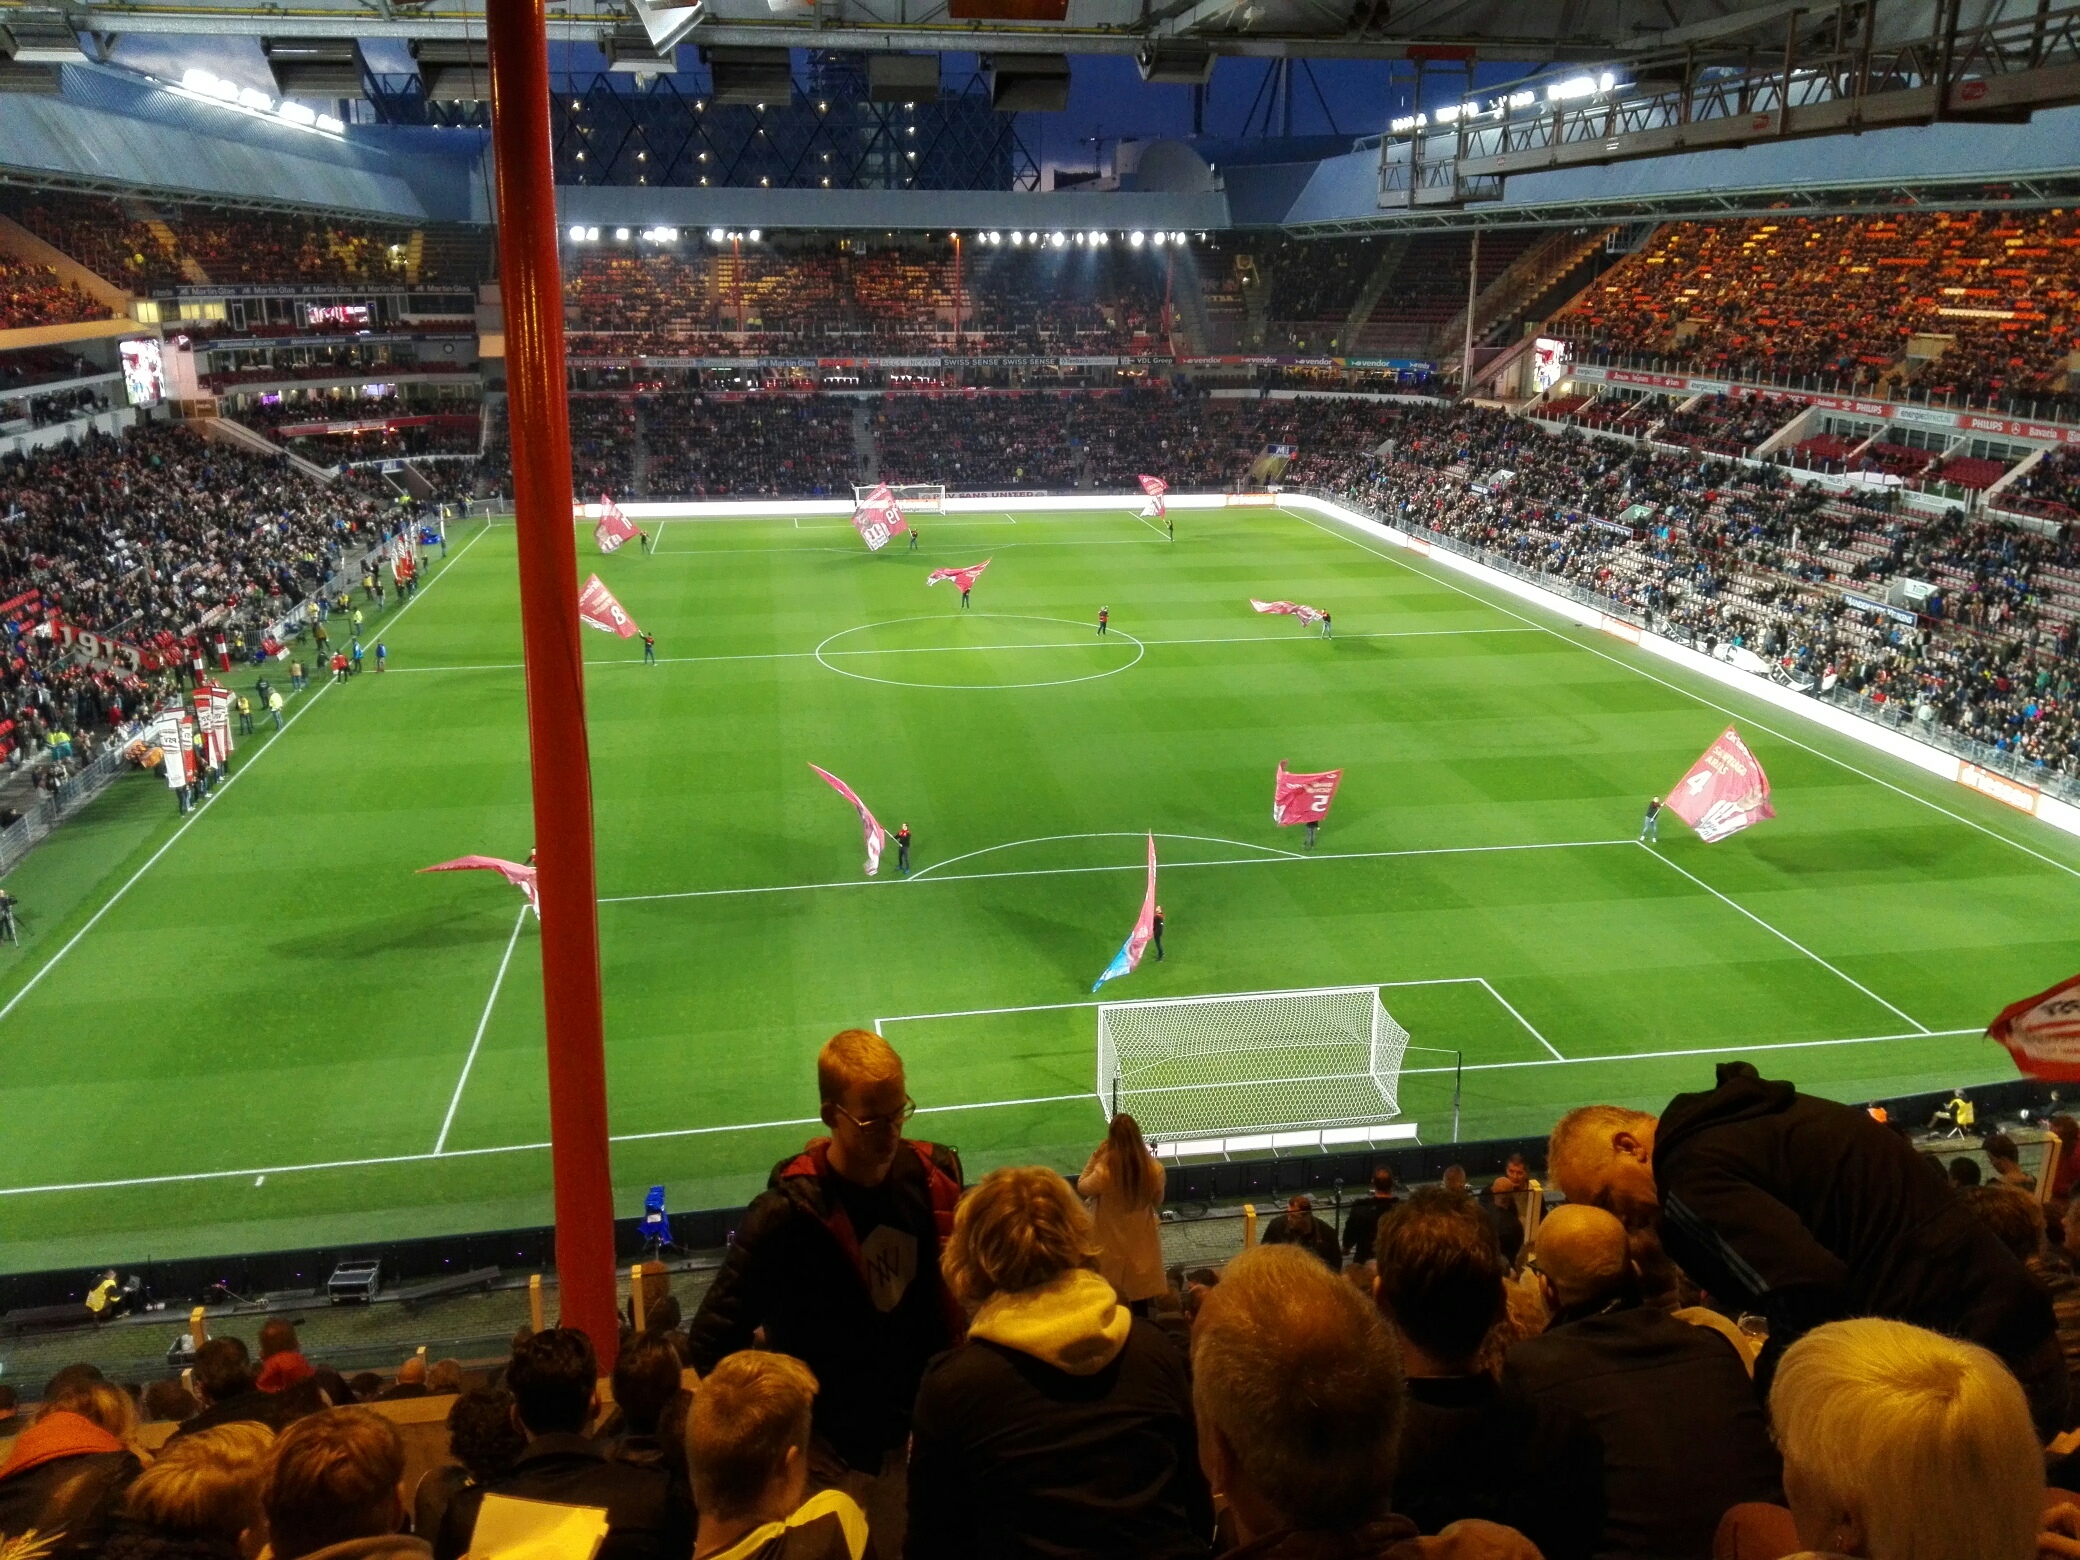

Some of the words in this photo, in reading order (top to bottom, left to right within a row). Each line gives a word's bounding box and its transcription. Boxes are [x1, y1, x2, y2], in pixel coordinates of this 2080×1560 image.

[192, 287, 217, 295] Martin
[218, 286, 236, 295] Glas
[254, 286, 278, 294] Martin
[279, 286, 296, 294] Glas
[313, 285, 336, 293] Martin
[336, 285, 353, 293] Glas
[1306, 358, 1332, 366] vendor
[1856, 402, 1882, 415] PHILIPS
[1972, 417, 2003, 432] PHILIPS
[2029, 427, 2058, 439] Bavaria
[610, 605, 626, 626] 8
[1704, 755, 1729, 776] ARIAS
[1687, 770, 1713, 796] 4
